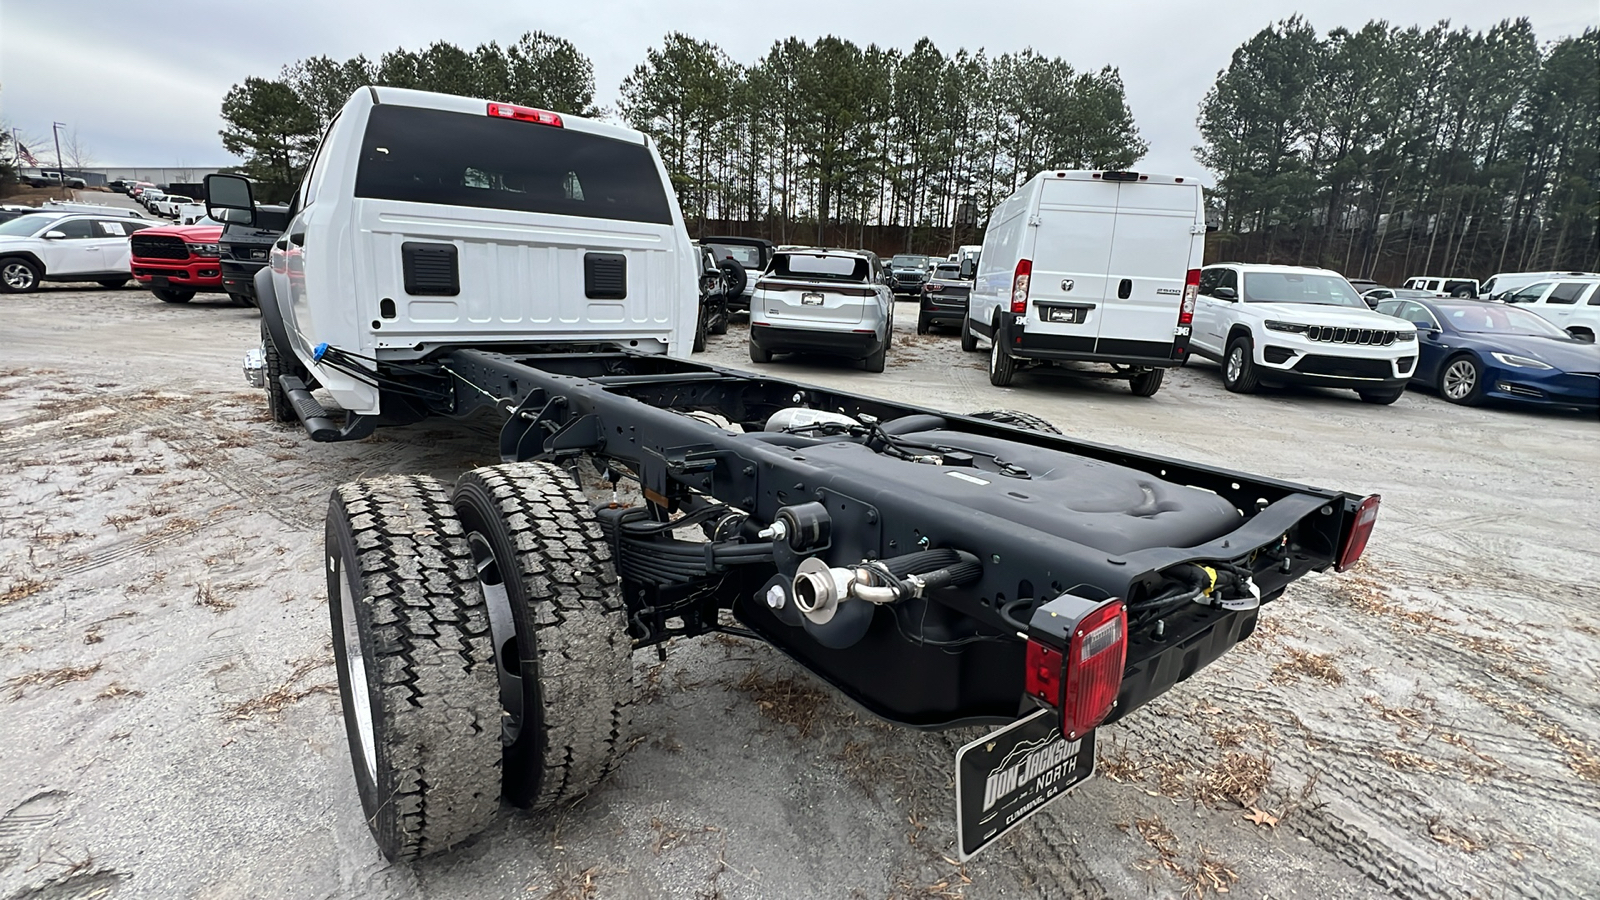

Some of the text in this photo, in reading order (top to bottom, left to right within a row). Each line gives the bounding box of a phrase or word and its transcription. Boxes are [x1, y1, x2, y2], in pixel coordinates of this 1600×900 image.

[983, 764, 1019, 812] DON
[1035, 756, 1077, 793] NORTH
[1047, 786, 1058, 797] GA
